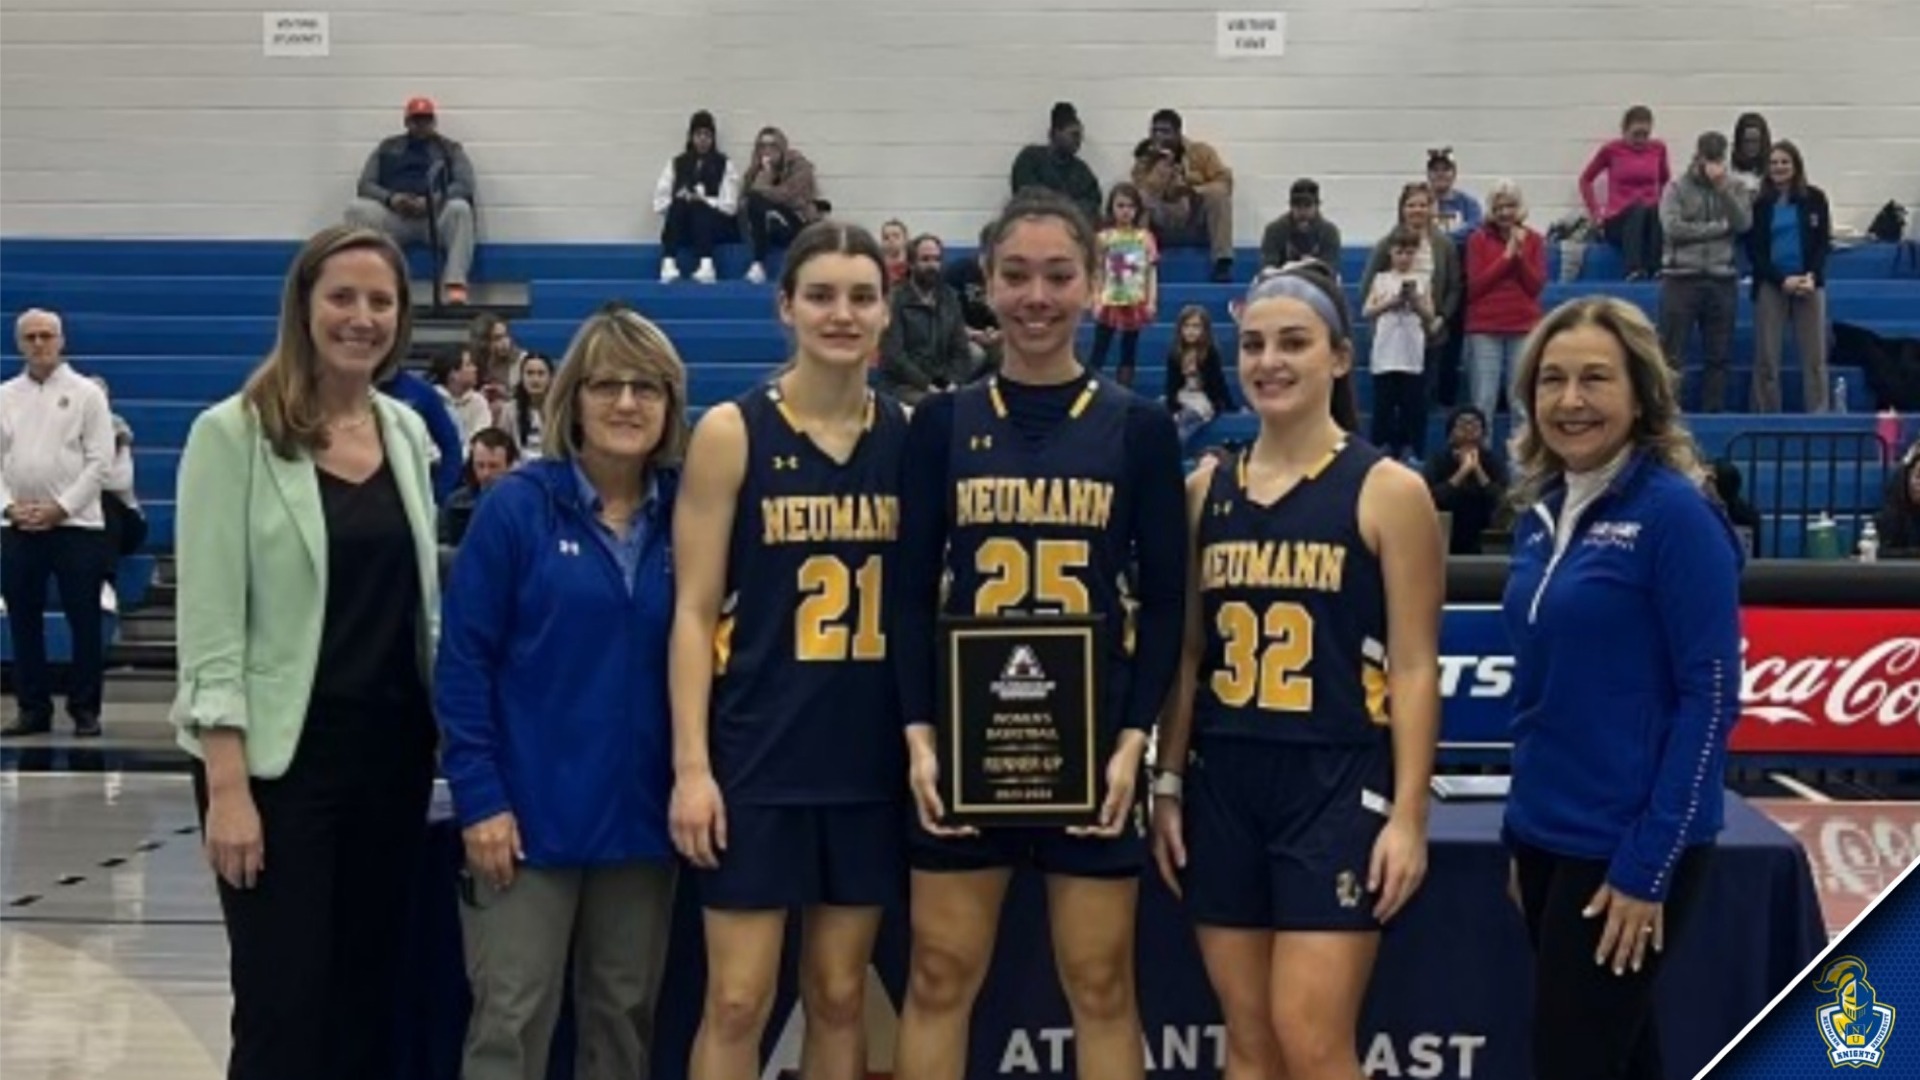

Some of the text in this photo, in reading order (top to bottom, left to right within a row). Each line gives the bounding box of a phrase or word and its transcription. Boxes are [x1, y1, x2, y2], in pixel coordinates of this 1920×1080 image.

[957, 477, 1114, 529] NEUMANN
[795, 554, 887, 661] 21
[975, 537, 1090, 617] 25
[1211, 602, 1312, 711] 32
